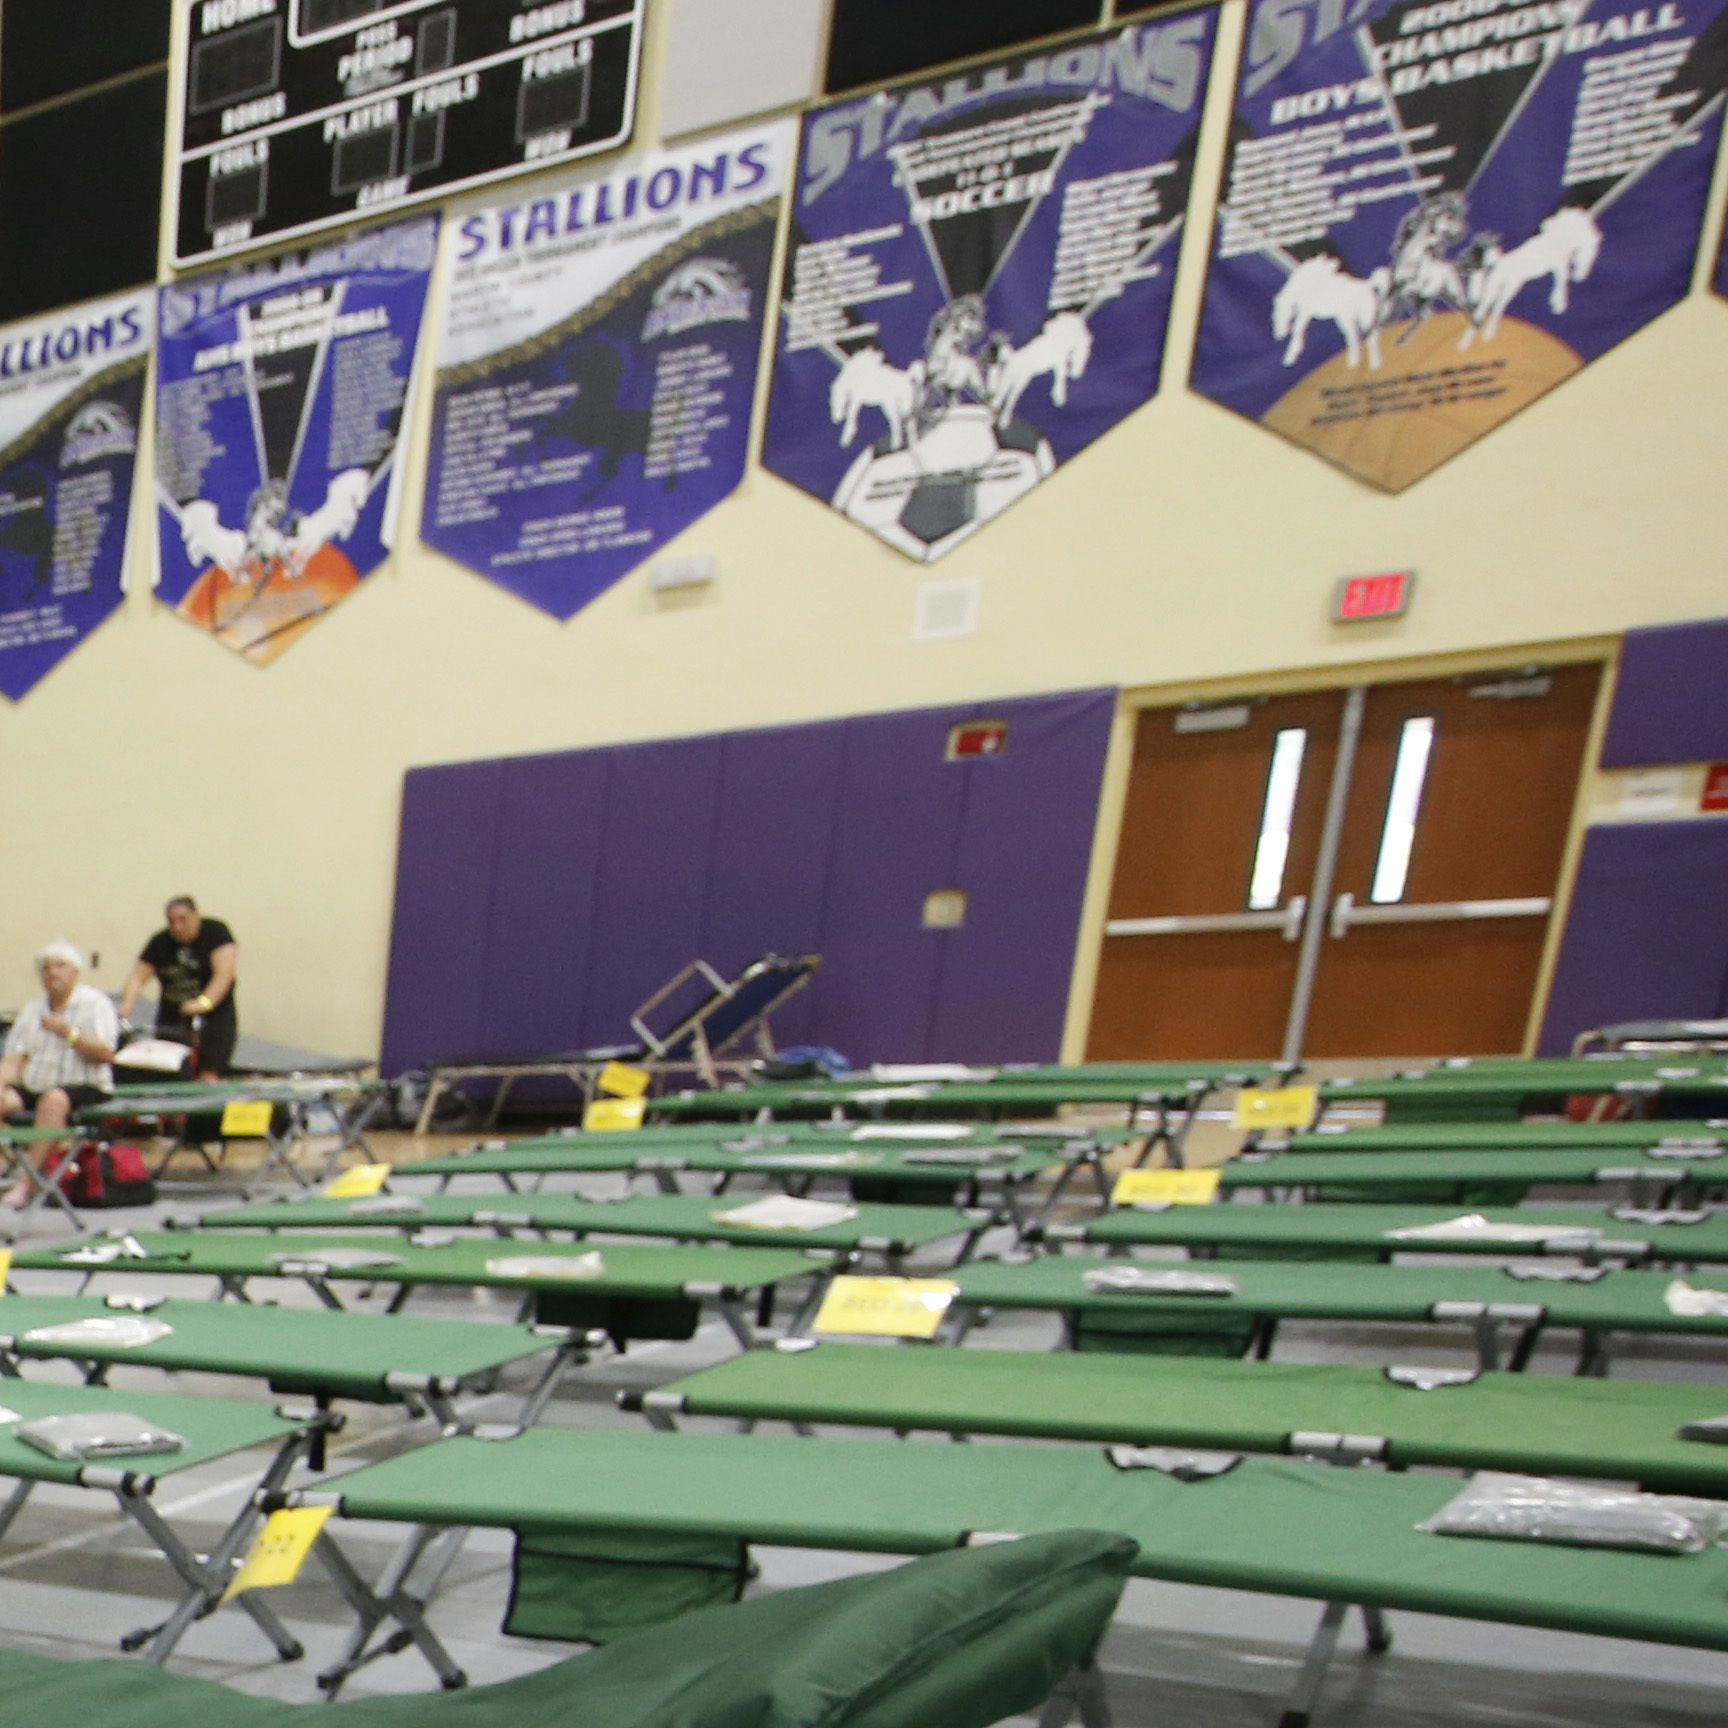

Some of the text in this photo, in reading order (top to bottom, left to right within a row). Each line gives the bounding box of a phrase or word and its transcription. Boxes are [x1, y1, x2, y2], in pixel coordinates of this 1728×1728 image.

[201, 0, 278, 35] HOME
[508, 0, 585, 43] BONUS
[337, 35, 414, 84] PERIOD
[521, 37, 595, 82] FOULS
[1389, 2, 1686, 97] BASKETBALL
[221, 91, 287, 135] BONUS
[410, 73, 480, 115] FOULS
[802, 16, 1206, 206] STALLIONS
[323, 98, 399, 144] PLAYER
[209, 138, 271, 176] FOULS
[459, 142, 768, 261] STALLIONS
[910, 170, 1055, 224] SOCCER
